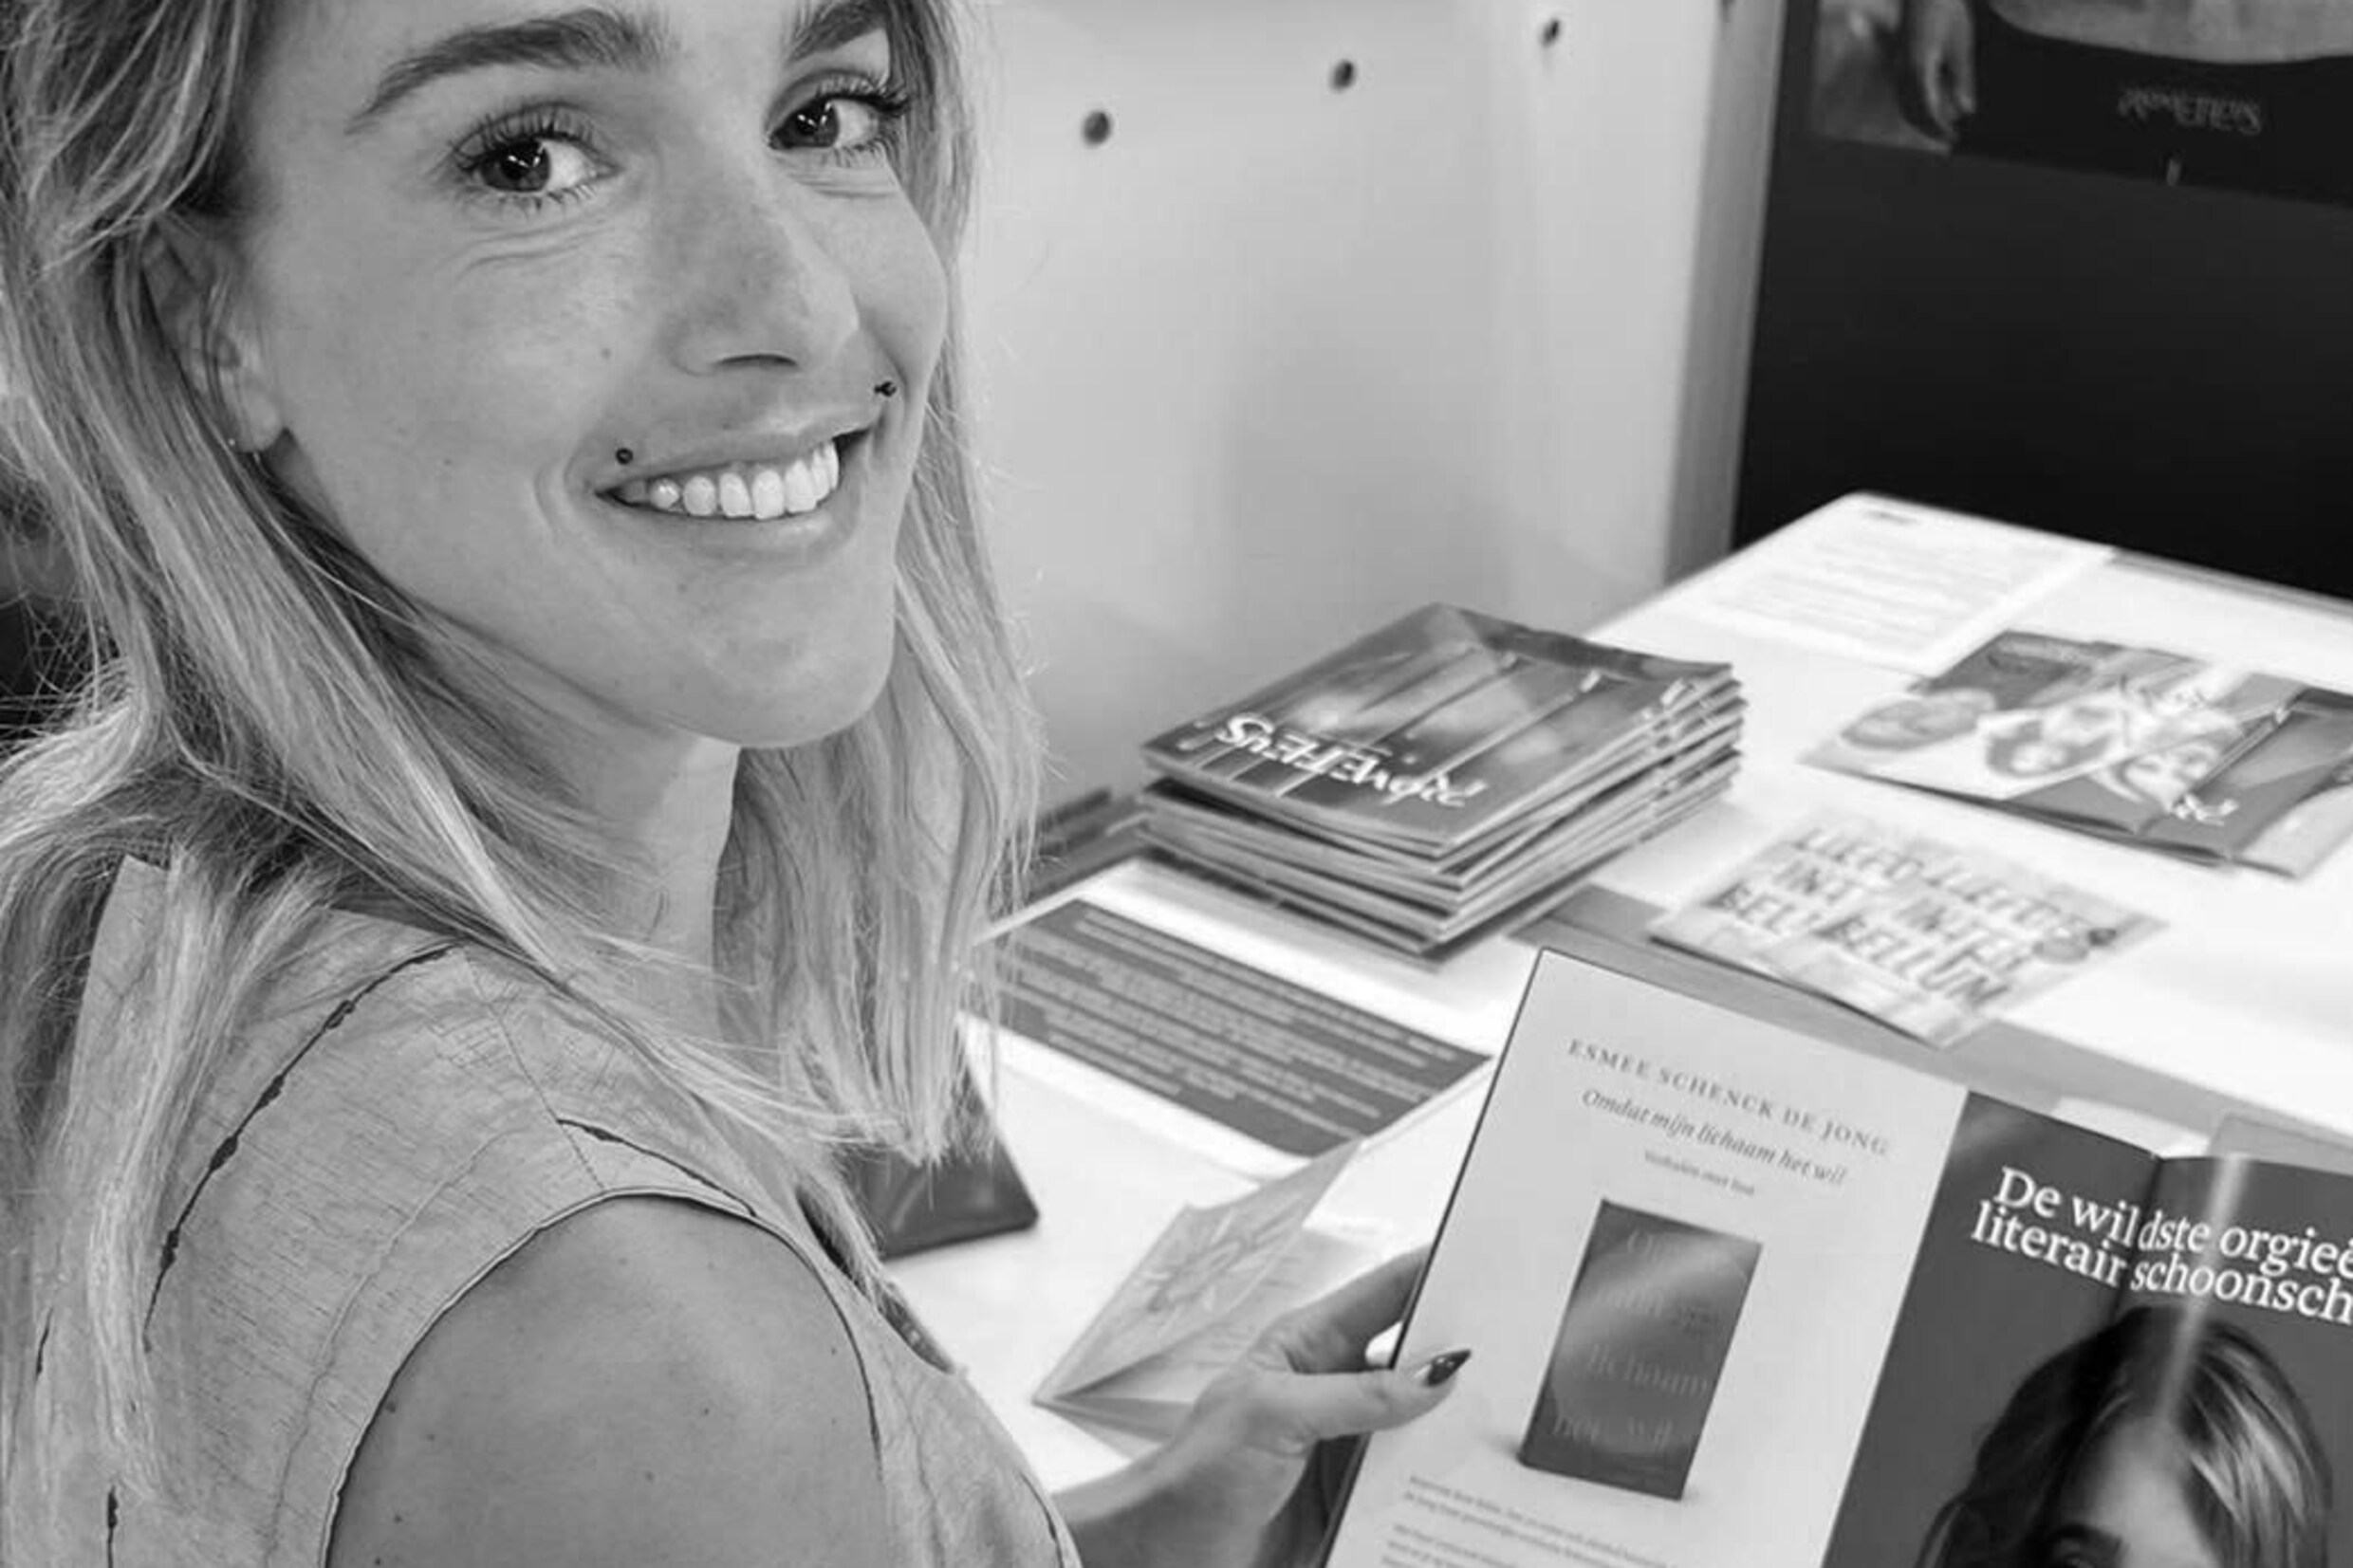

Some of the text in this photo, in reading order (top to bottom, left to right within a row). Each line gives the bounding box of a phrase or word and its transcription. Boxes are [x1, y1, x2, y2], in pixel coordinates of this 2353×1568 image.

[1581, 1090, 1847, 1185] Omdat mijn lichaam het wil
[1658, 1067, 1774, 1119] SCHENCK
[1783, 1106, 1816, 1132] DE
[1821, 1120, 1889, 1155] JONG
[1992, 1166, 2062, 1218] De
[2071, 1195, 2211, 1252] wildste
[1970, 1200, 2353, 1324] literair schoonsch
